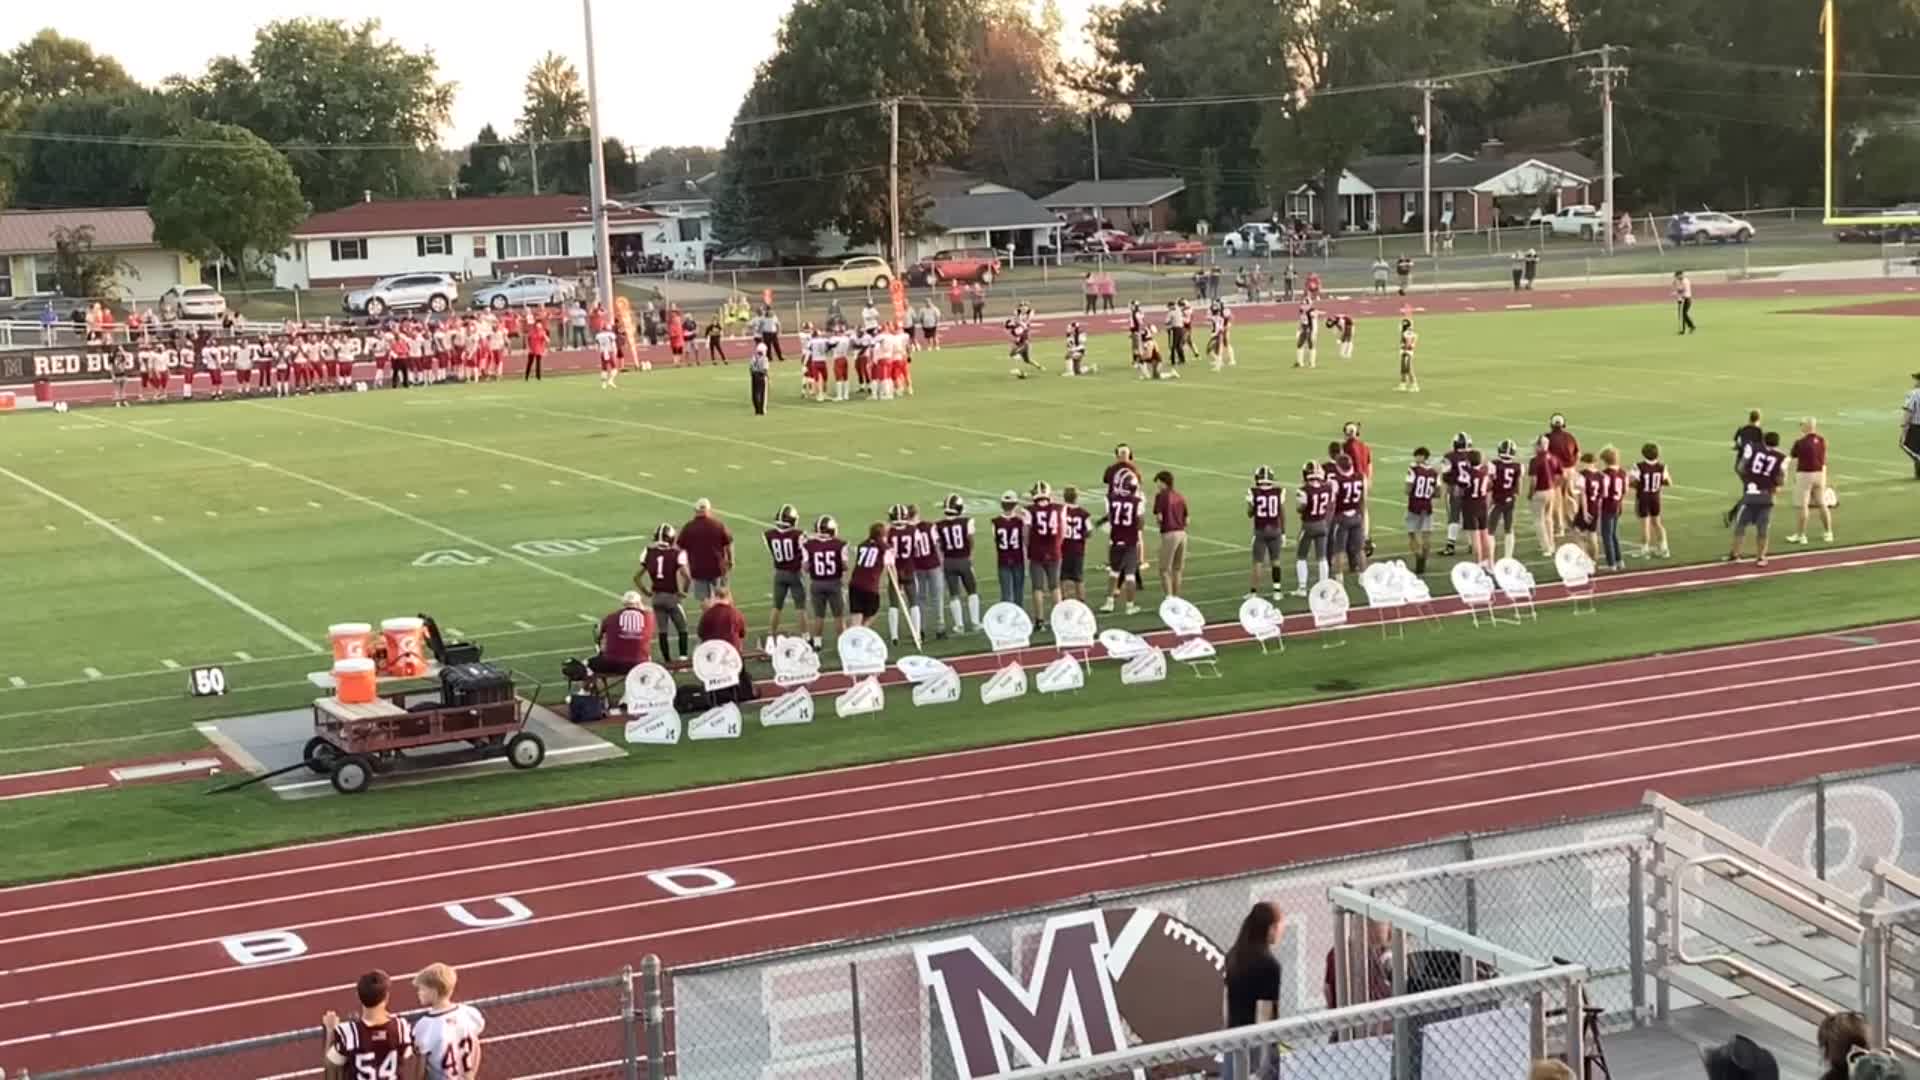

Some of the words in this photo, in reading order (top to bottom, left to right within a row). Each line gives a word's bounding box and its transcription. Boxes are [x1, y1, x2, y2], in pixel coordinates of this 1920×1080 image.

[33, 354, 80, 376] RED
[1752, 452, 1777, 477] 67
[1415, 476, 1434, 498] 86
[1503, 468, 1515, 489] 5
[1643, 472, 1661, 492] 10
[1311, 492, 1330, 516] 12
[1343, 481, 1362, 504] 75
[1112, 501, 1133, 526] 73
[1256, 495, 1278, 517] 20
[1036, 510, 1059, 535] 54
[943, 524, 964, 550] 18
[997, 527, 1020, 550] 34
[771, 538, 794, 562] 80
[857, 546, 879, 568] 70
[656, 556, 665, 579] 1
[814, 551, 836, 576] 65
[195, 668, 225, 694] 50
[354, 1050, 400, 1080] 54
